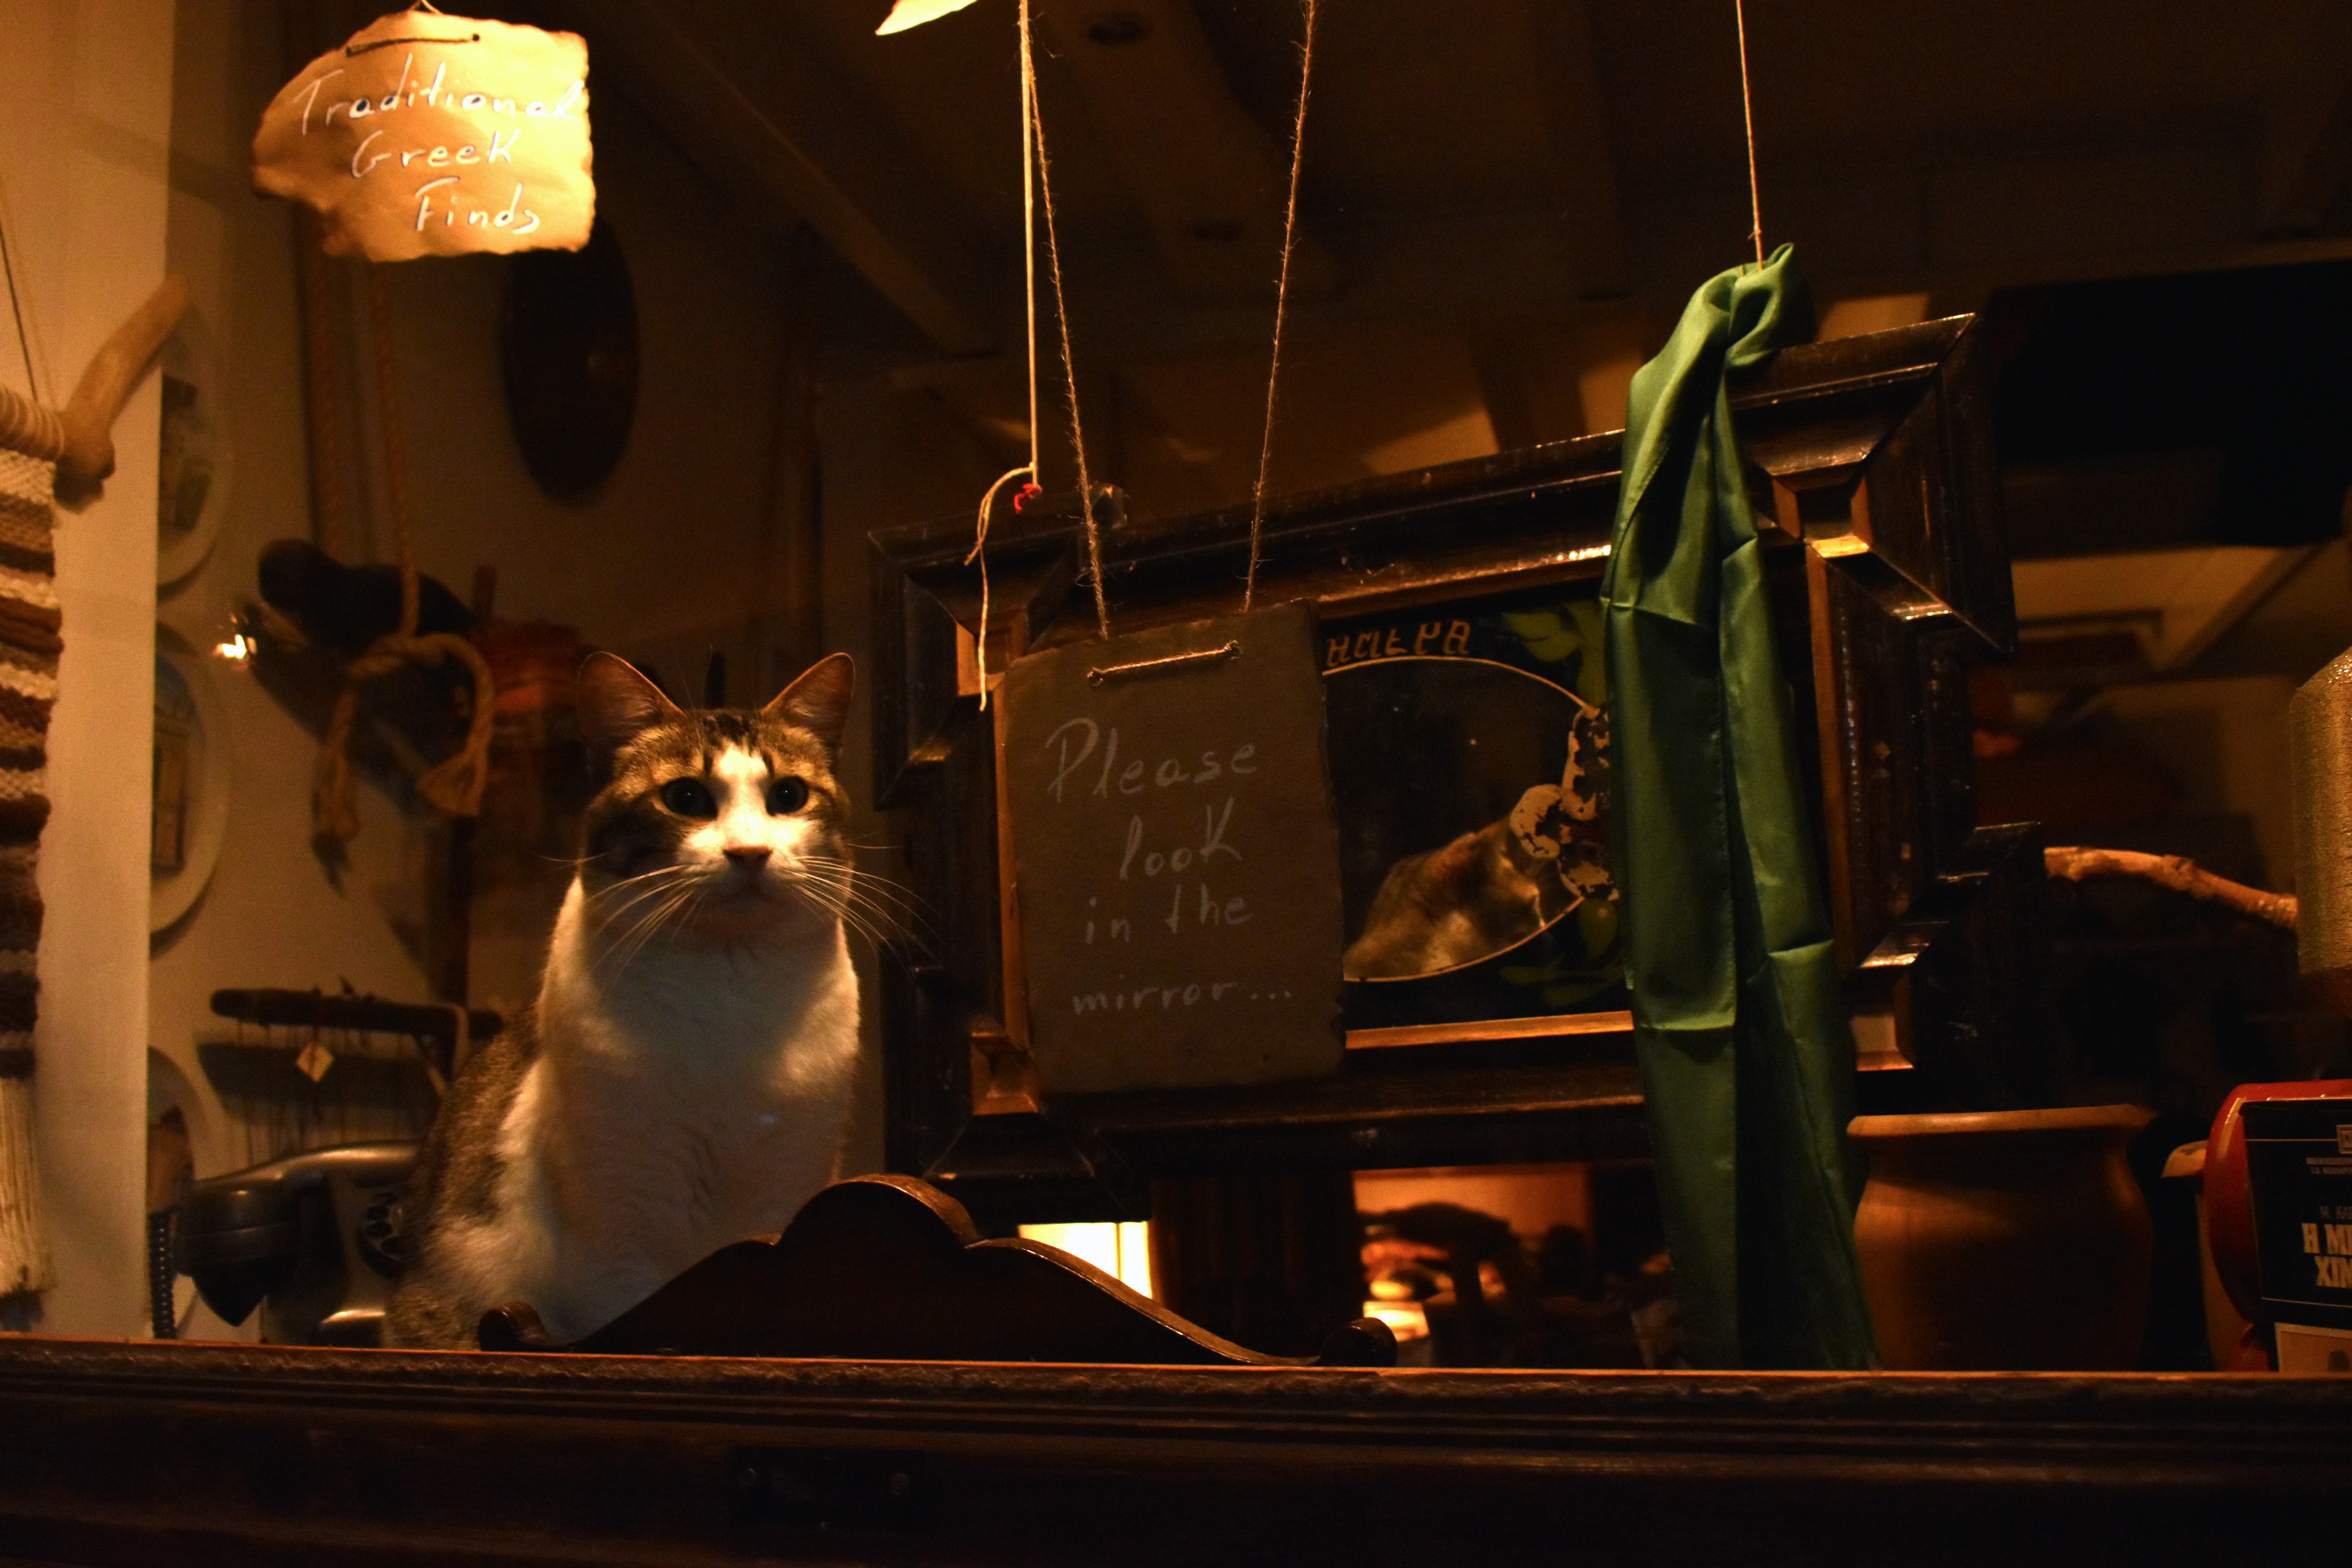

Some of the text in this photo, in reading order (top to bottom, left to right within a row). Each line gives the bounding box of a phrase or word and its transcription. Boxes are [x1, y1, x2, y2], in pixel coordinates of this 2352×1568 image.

[293, 53, 584, 135] Traditional
[415, 176, 541, 234] Finds
[1045, 717, 1258, 803] Please
[1085, 882, 1255, 944] in the
[1072, 973, 1291, 1016] mirror...
